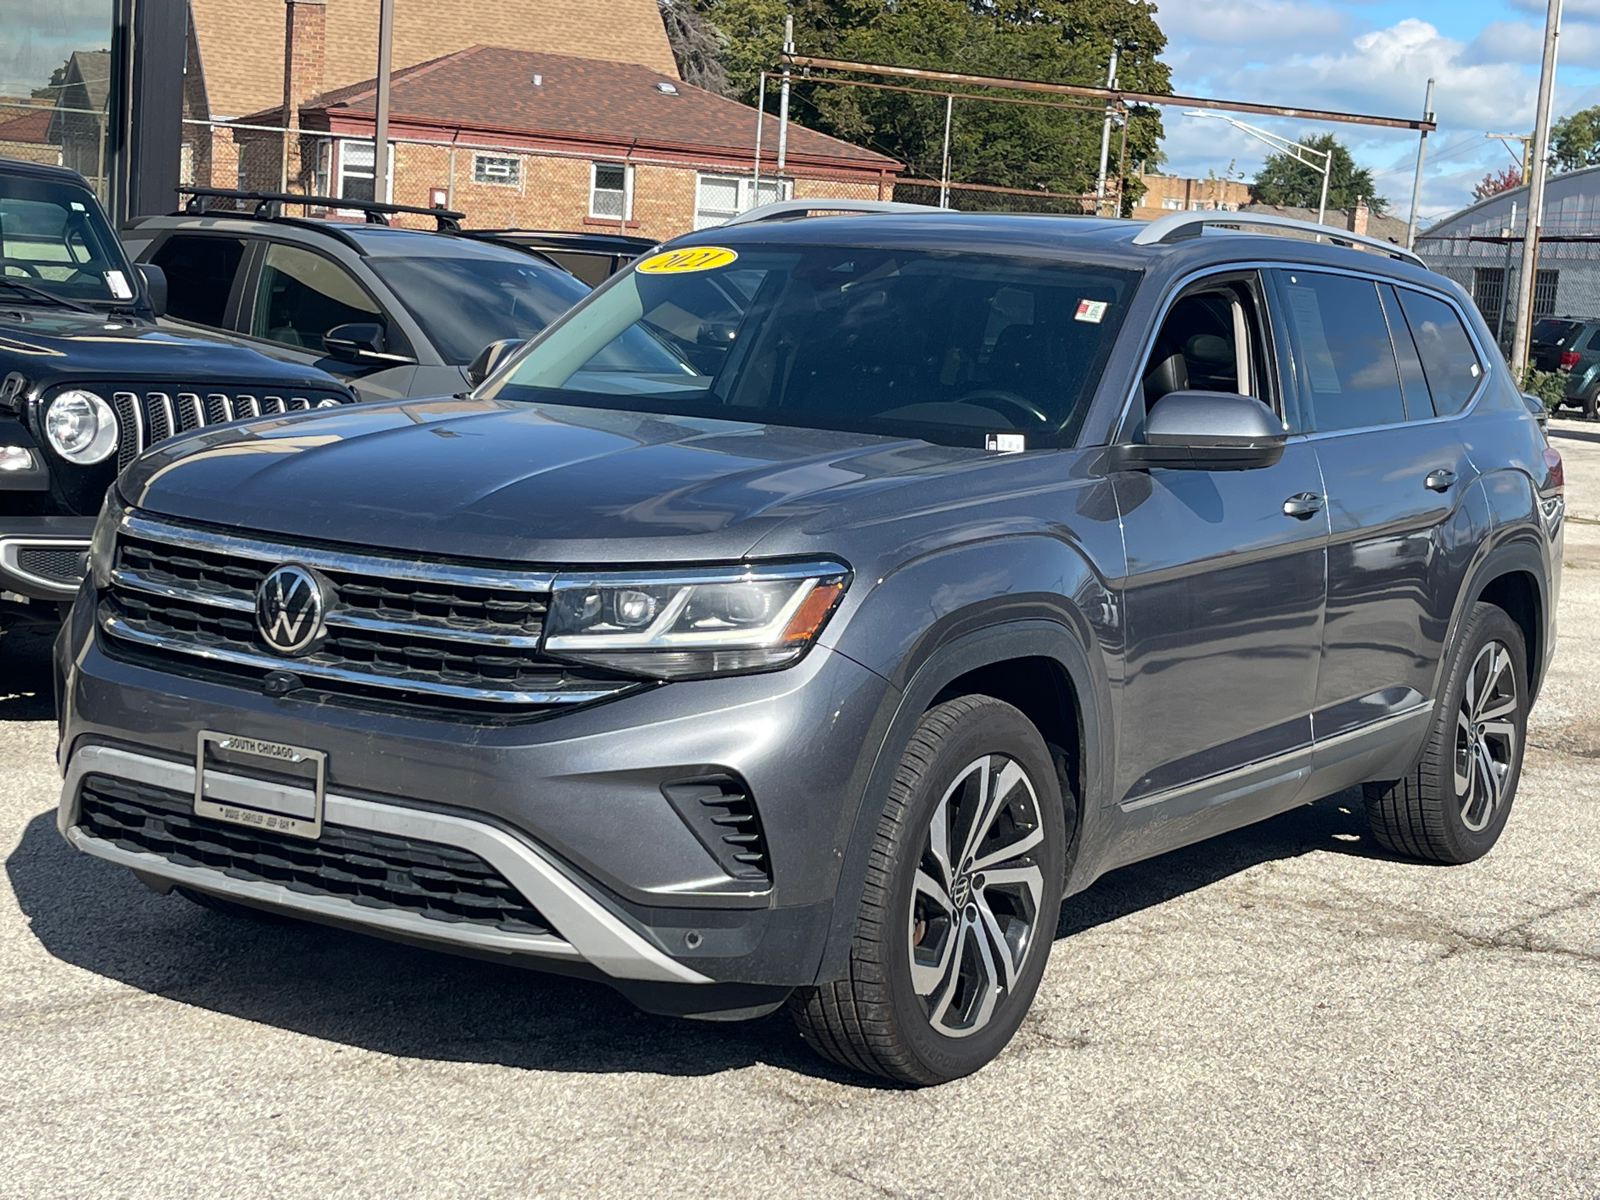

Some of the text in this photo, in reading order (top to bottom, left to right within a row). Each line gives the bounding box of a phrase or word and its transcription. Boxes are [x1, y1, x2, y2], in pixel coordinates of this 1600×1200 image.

[646, 252, 724, 269] 2021
[228, 737, 293, 758] SOUTH CHICAGO
